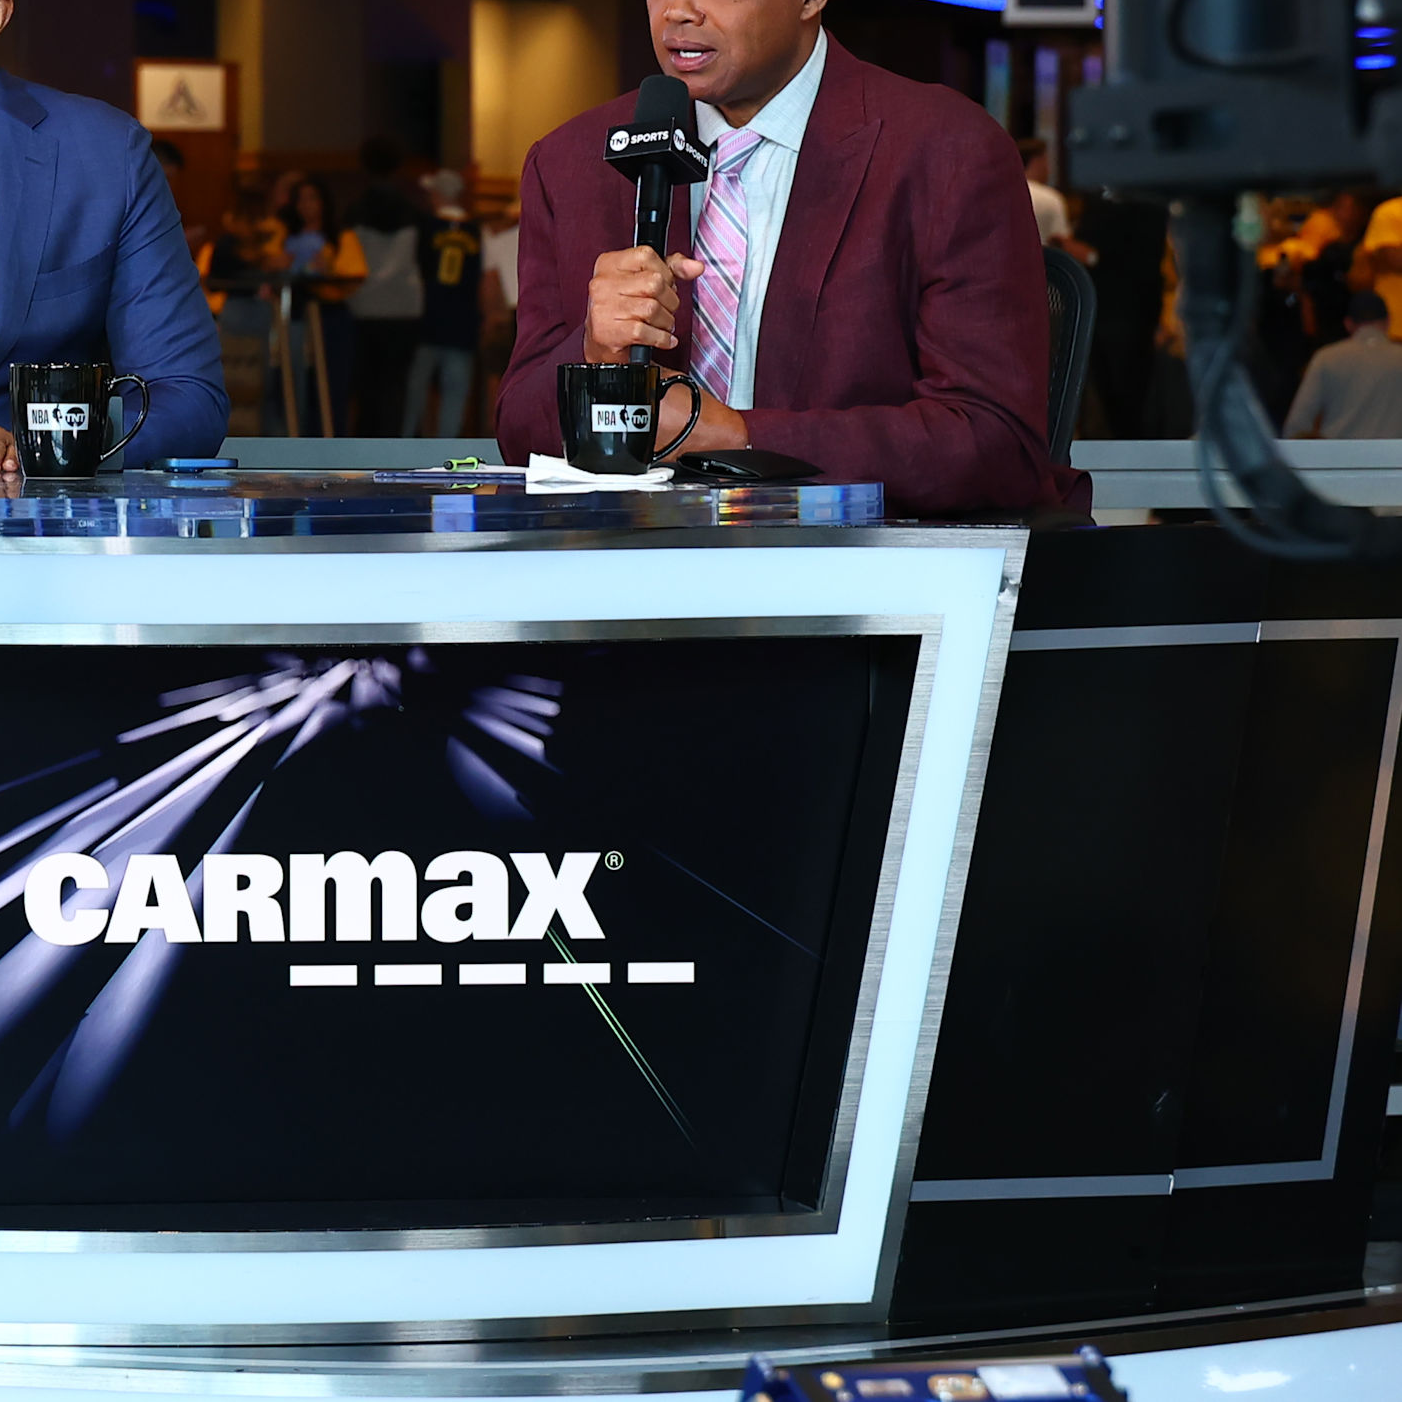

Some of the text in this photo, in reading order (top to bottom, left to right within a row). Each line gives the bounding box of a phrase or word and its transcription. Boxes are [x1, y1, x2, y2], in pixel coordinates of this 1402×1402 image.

[631, 130, 669, 144] SPORTS
[686, 142, 708, 168] SPORTS
[31, 409, 49, 424] NBA
[597, 410, 616, 426] NBA
